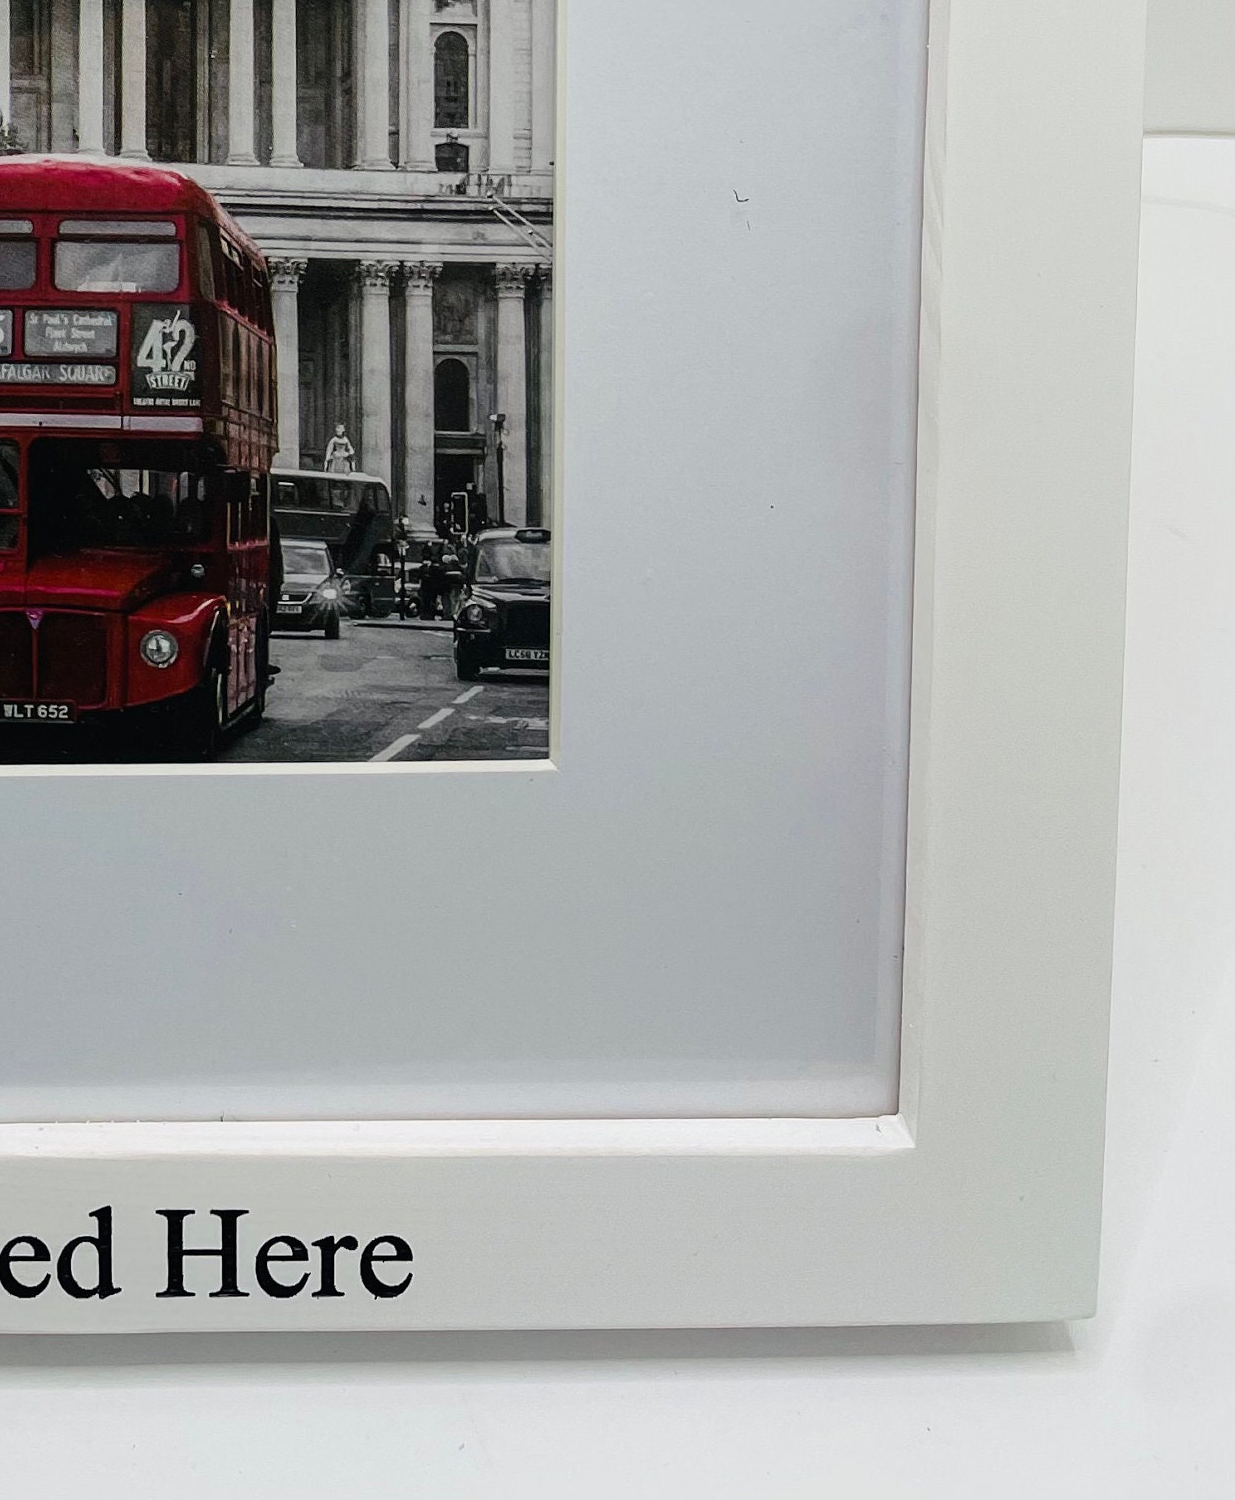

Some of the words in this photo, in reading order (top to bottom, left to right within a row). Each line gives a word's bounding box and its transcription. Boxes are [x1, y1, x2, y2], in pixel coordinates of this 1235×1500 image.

[149, 373, 187, 389] STREET
[3, 704, 35, 718] WLT
[37, 704, 69, 719] 652
[155, 1208, 414, 1301] Here
